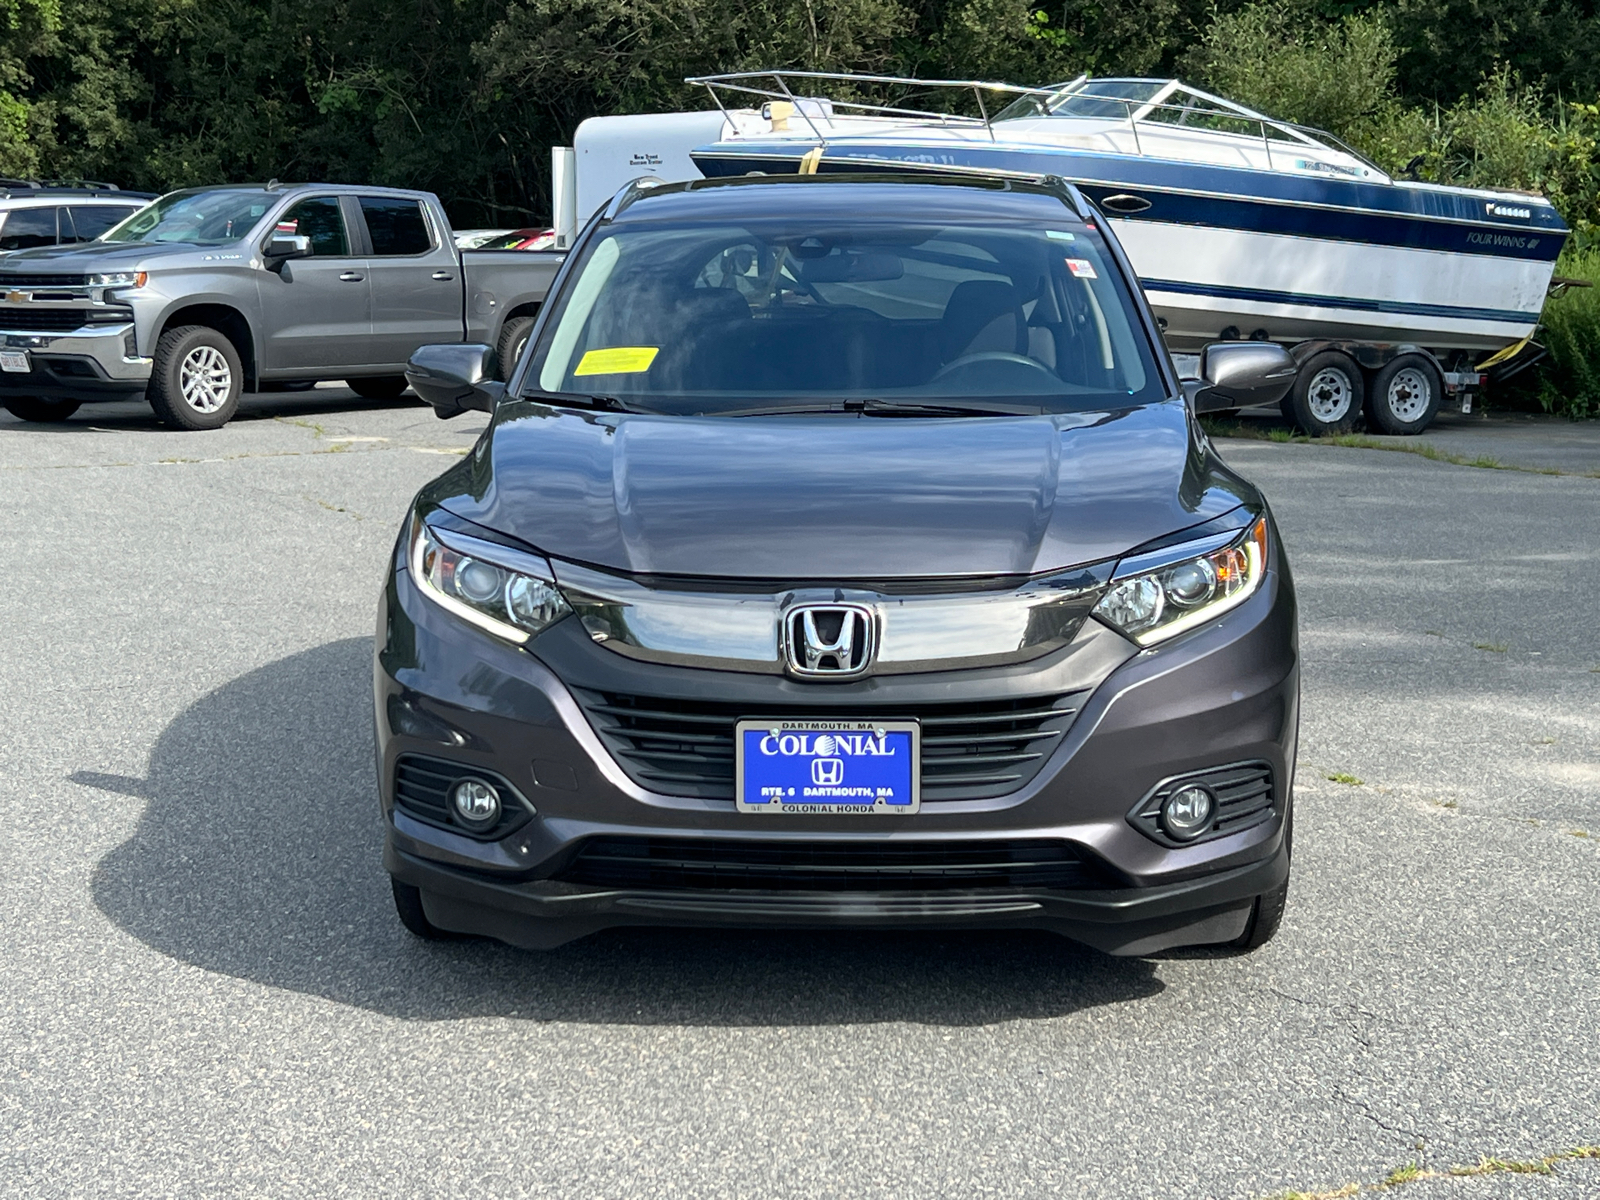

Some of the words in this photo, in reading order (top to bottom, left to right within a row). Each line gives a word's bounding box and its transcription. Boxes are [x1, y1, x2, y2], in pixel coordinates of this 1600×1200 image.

[1466, 232, 1493, 245] FOUR
[1493, 234, 1527, 248] WINNS
[759, 735, 896, 756] COLONIAL
[761, 787, 786, 796] RTE.
[787, 787, 796, 796] 6
[803, 787, 874, 797] DARTMOUTH,
[877, 787, 894, 797] MA
[781, 805, 836, 813] COLONIAL
[837, 805, 875, 813] HONDA
